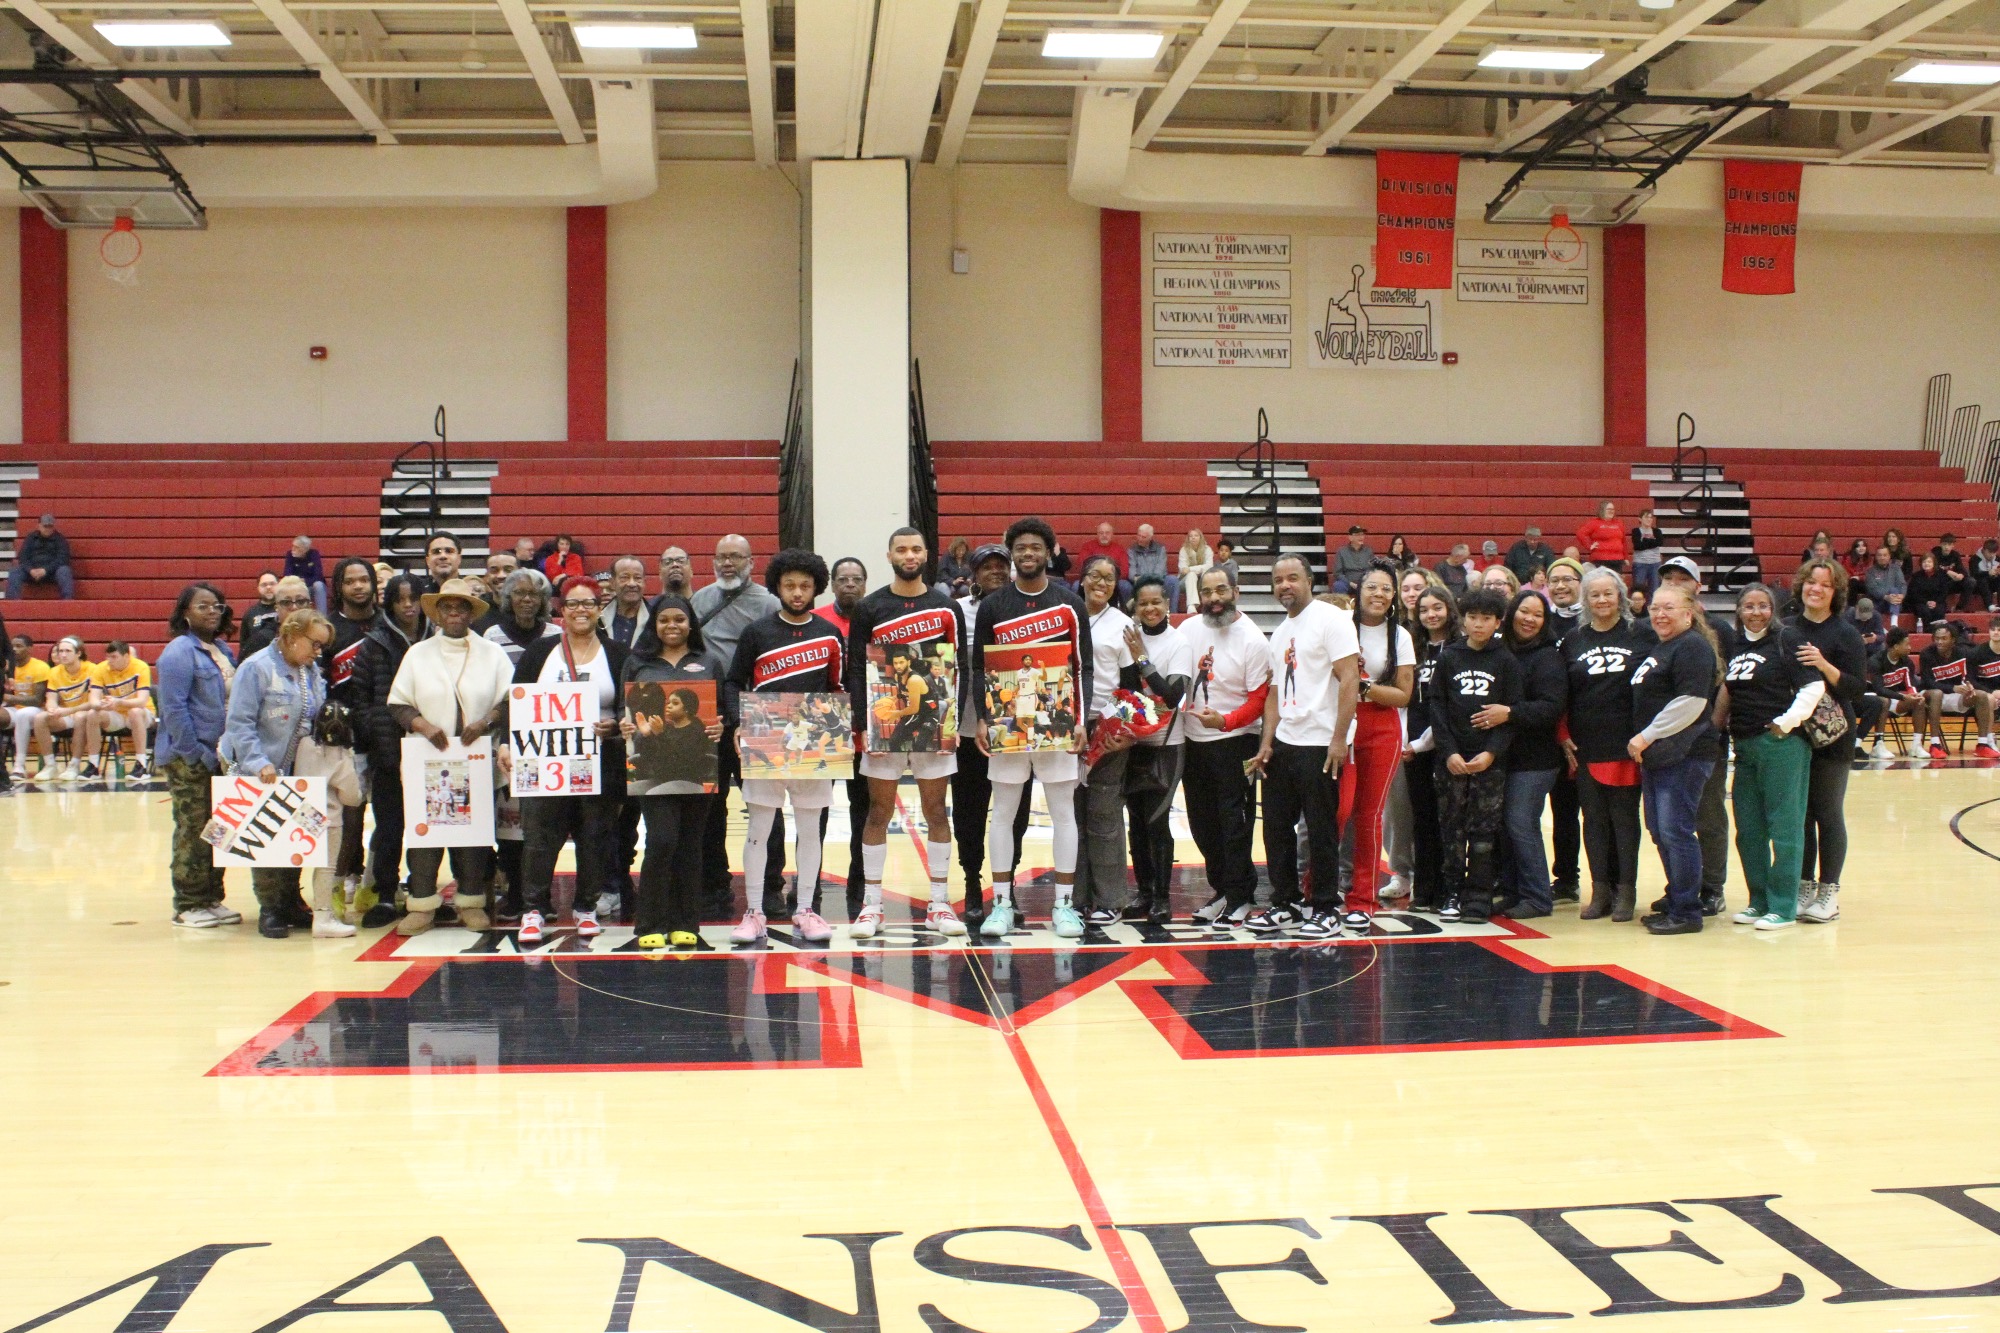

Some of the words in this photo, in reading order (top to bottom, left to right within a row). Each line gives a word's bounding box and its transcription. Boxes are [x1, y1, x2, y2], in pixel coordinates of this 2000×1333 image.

[1381, 179, 1454, 195] DIVISION
[1728, 187, 1796, 203] DIVISION
[1377, 214, 1456, 231] CHAMPIONS
[1725, 222, 1797, 236] CHAMPIONS
[1213, 235, 1237, 243] AIAW
[1158, 243, 1212, 255] NATIONAL
[1214, 243, 1288, 256] TOURNAMENT
[1398, 251, 1431, 264] 1961
[1481, 248, 1507, 259] PSAC
[1743, 256, 1776, 270] 1962
[1163, 277, 1222, 290] REGIONAL
[1222, 279, 1281, 291] CHAMPIONS
[1462, 282, 1515, 294] NATIONAL
[1516, 283, 1585, 295] TOURNAMENT
[1160, 311, 1214, 323] NATIONAL
[1217, 312, 1288, 325] TOURNAMENT
[1215, 340, 1243, 348] NCAA
[1160, 347, 1215, 358] NATIONAL
[1217, 348, 1288, 359] TOURNAMENT
[761, 646, 829, 676] MANSFIELD
[1587, 654, 1626, 675] 22
[1726, 661, 1756, 680] 22
[1460, 678, 1490, 696] 22
[532, 692, 584, 723] I'M
[512, 727, 599, 757] WITH
[545, 761, 565, 792] 3
[212, 777, 263, 830] I'M
[229, 780, 305, 861] WITH
[289, 827, 317, 856] 3
